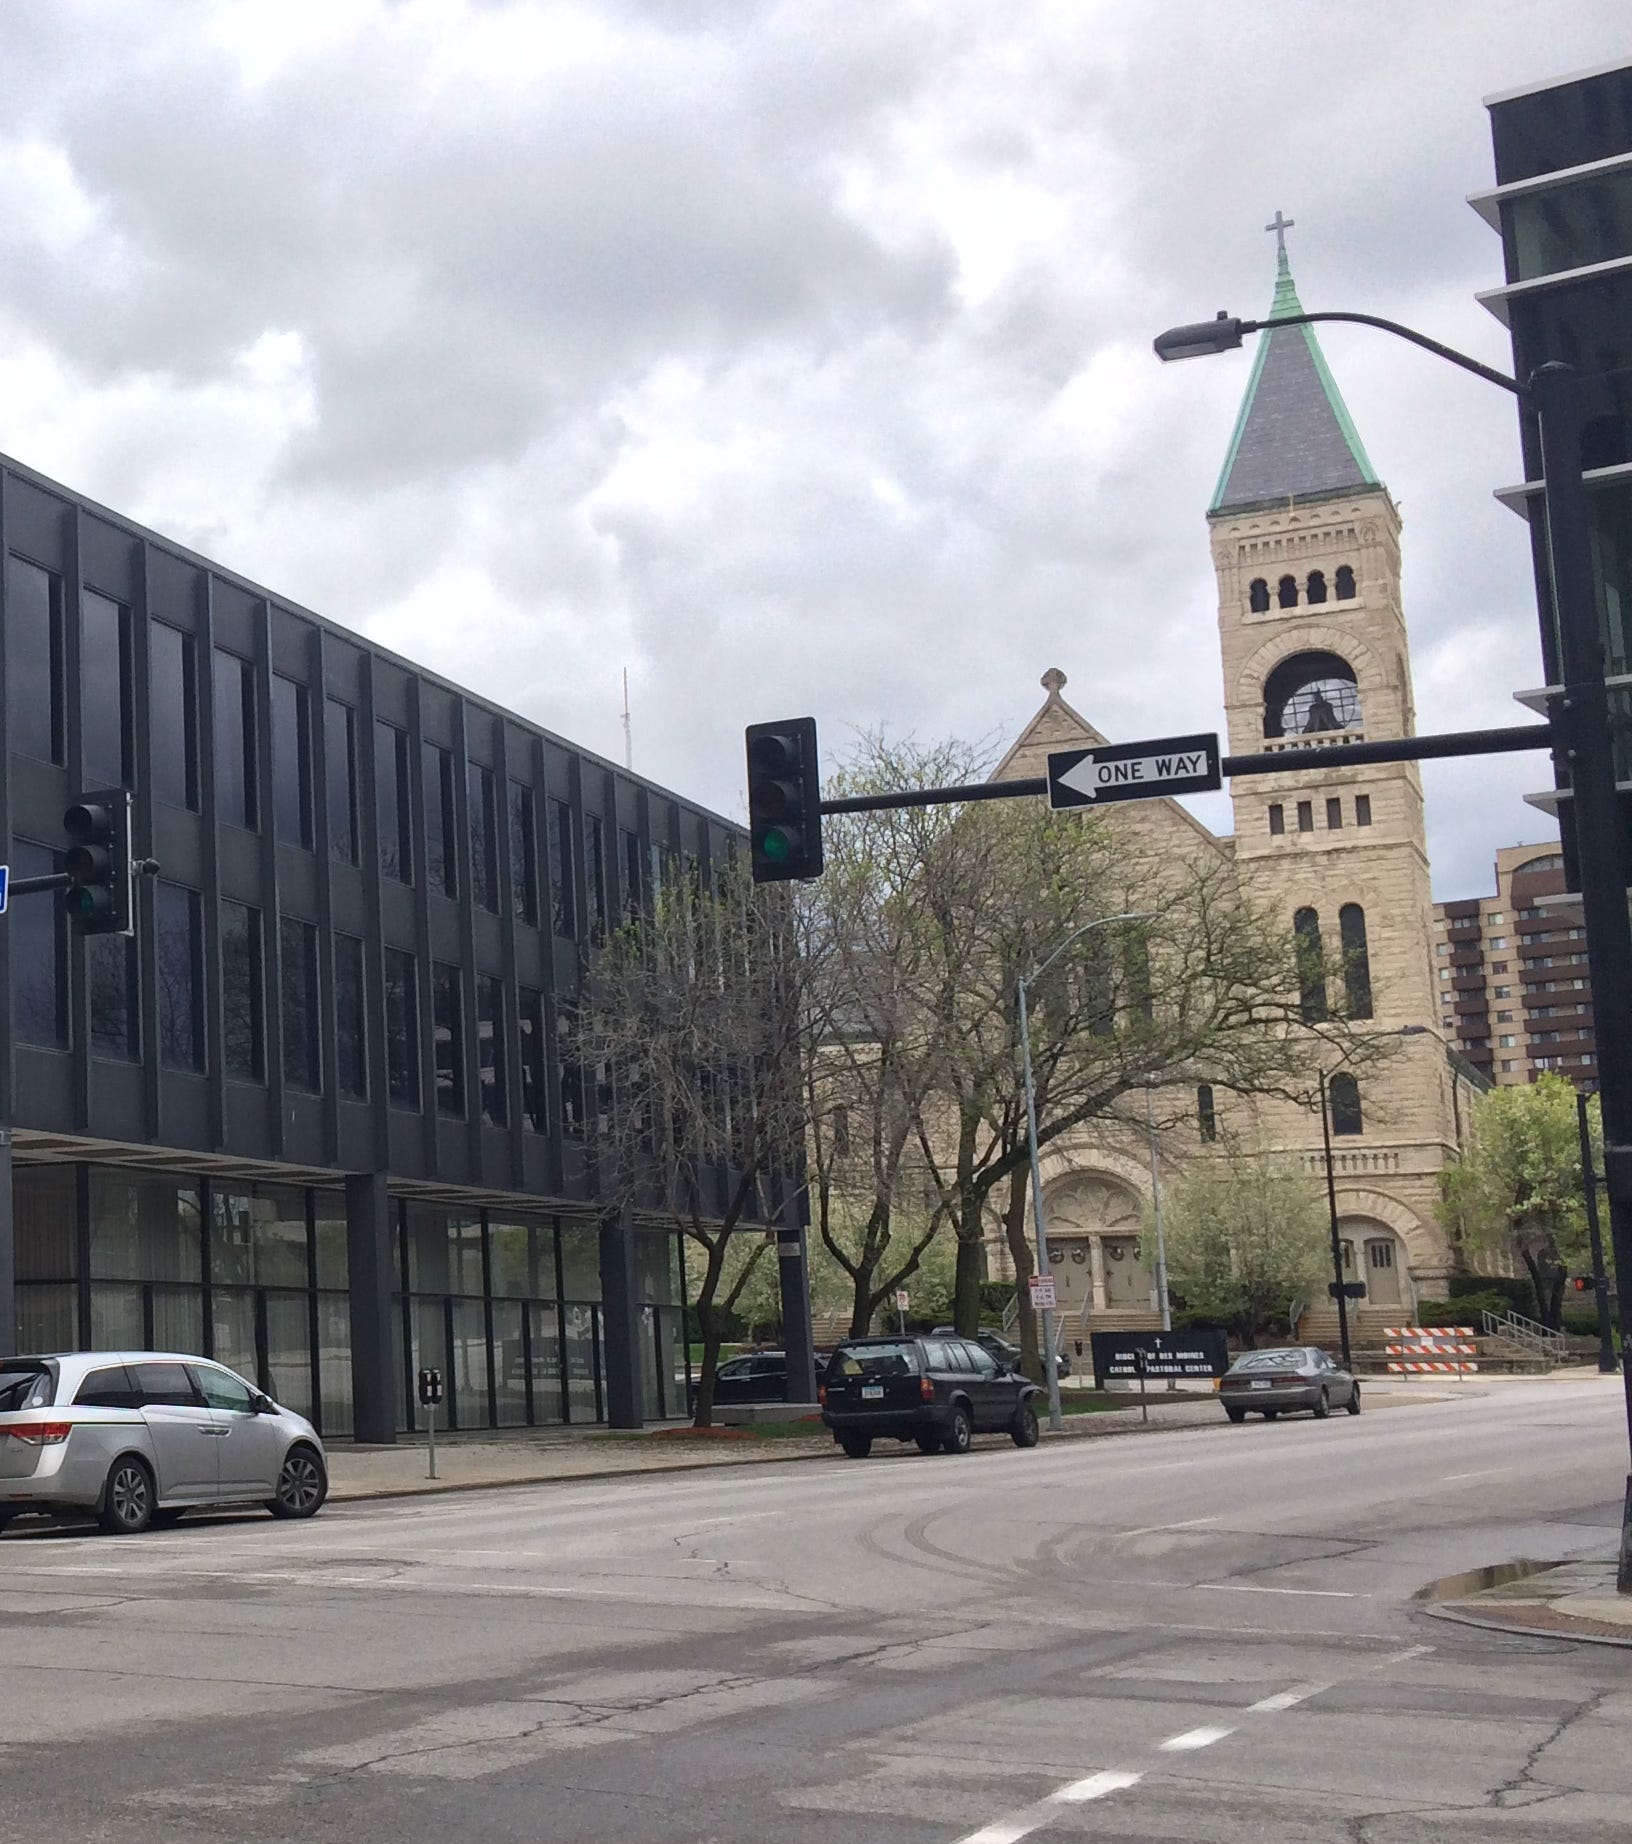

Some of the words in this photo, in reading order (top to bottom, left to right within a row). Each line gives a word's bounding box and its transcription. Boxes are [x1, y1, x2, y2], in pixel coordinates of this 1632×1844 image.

[1097, 762, 1145, 784] ONE
[1155, 754, 1202, 777] WAY
[1109, 1366, 1137, 1374] CATHOL
[1146, 1364, 1183, 1373] PASTORAL
[1185, 1364, 1213, 1373] CENTER
